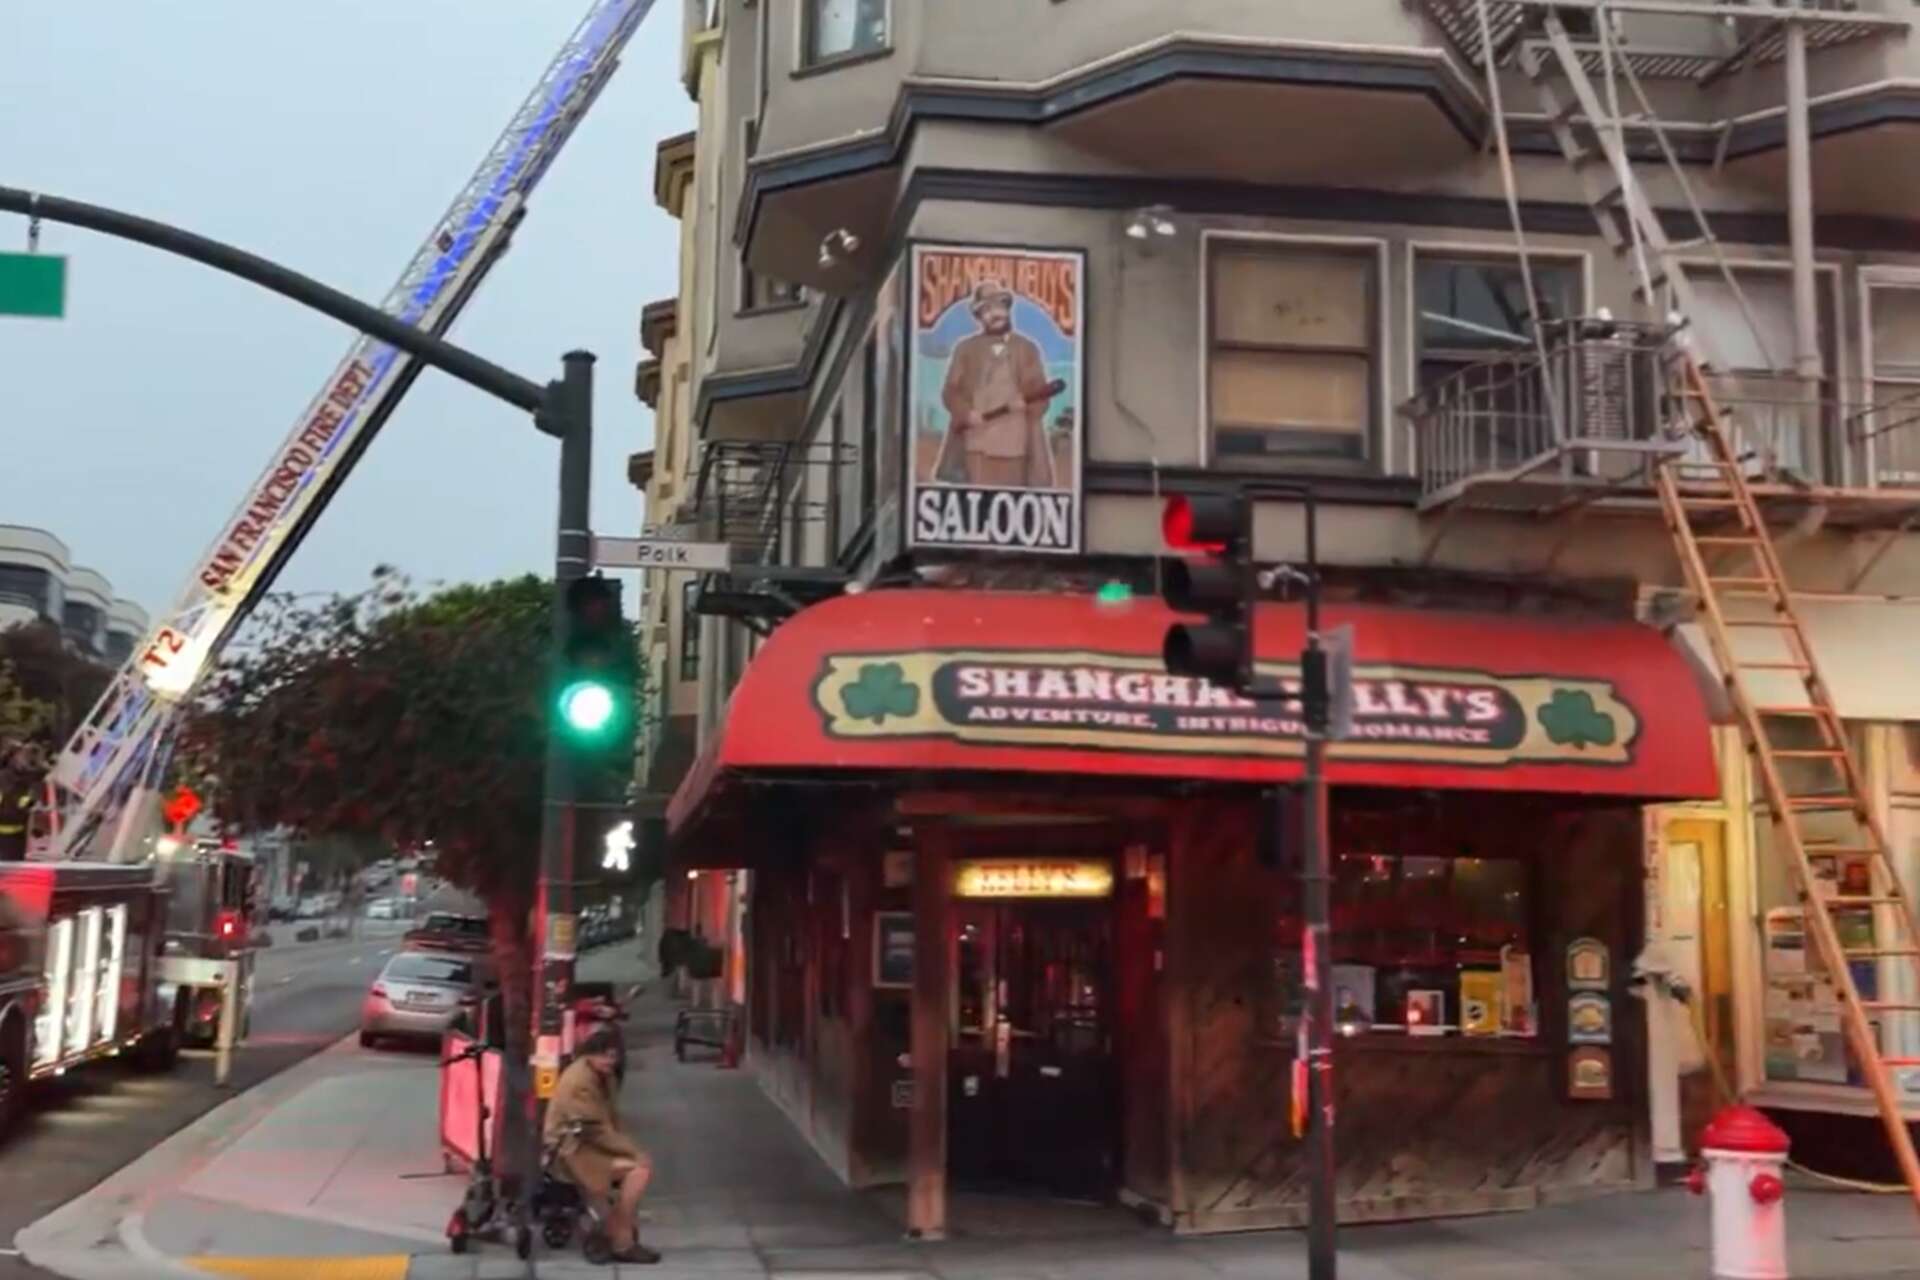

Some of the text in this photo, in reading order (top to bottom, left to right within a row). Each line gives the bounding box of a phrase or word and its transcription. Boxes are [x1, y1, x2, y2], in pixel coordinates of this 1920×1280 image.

[200, 545, 243, 588] SAN
[229, 447, 314, 551] FRANCISCO
[300, 402, 345, 452] FIRE
[917, 489, 1071, 547] SALOON
[638, 544, 688, 563] Polk
[957, 666, 1501, 723] SHANGHA LLY'S
[1176, 716, 1306, 734] INTRIGU
